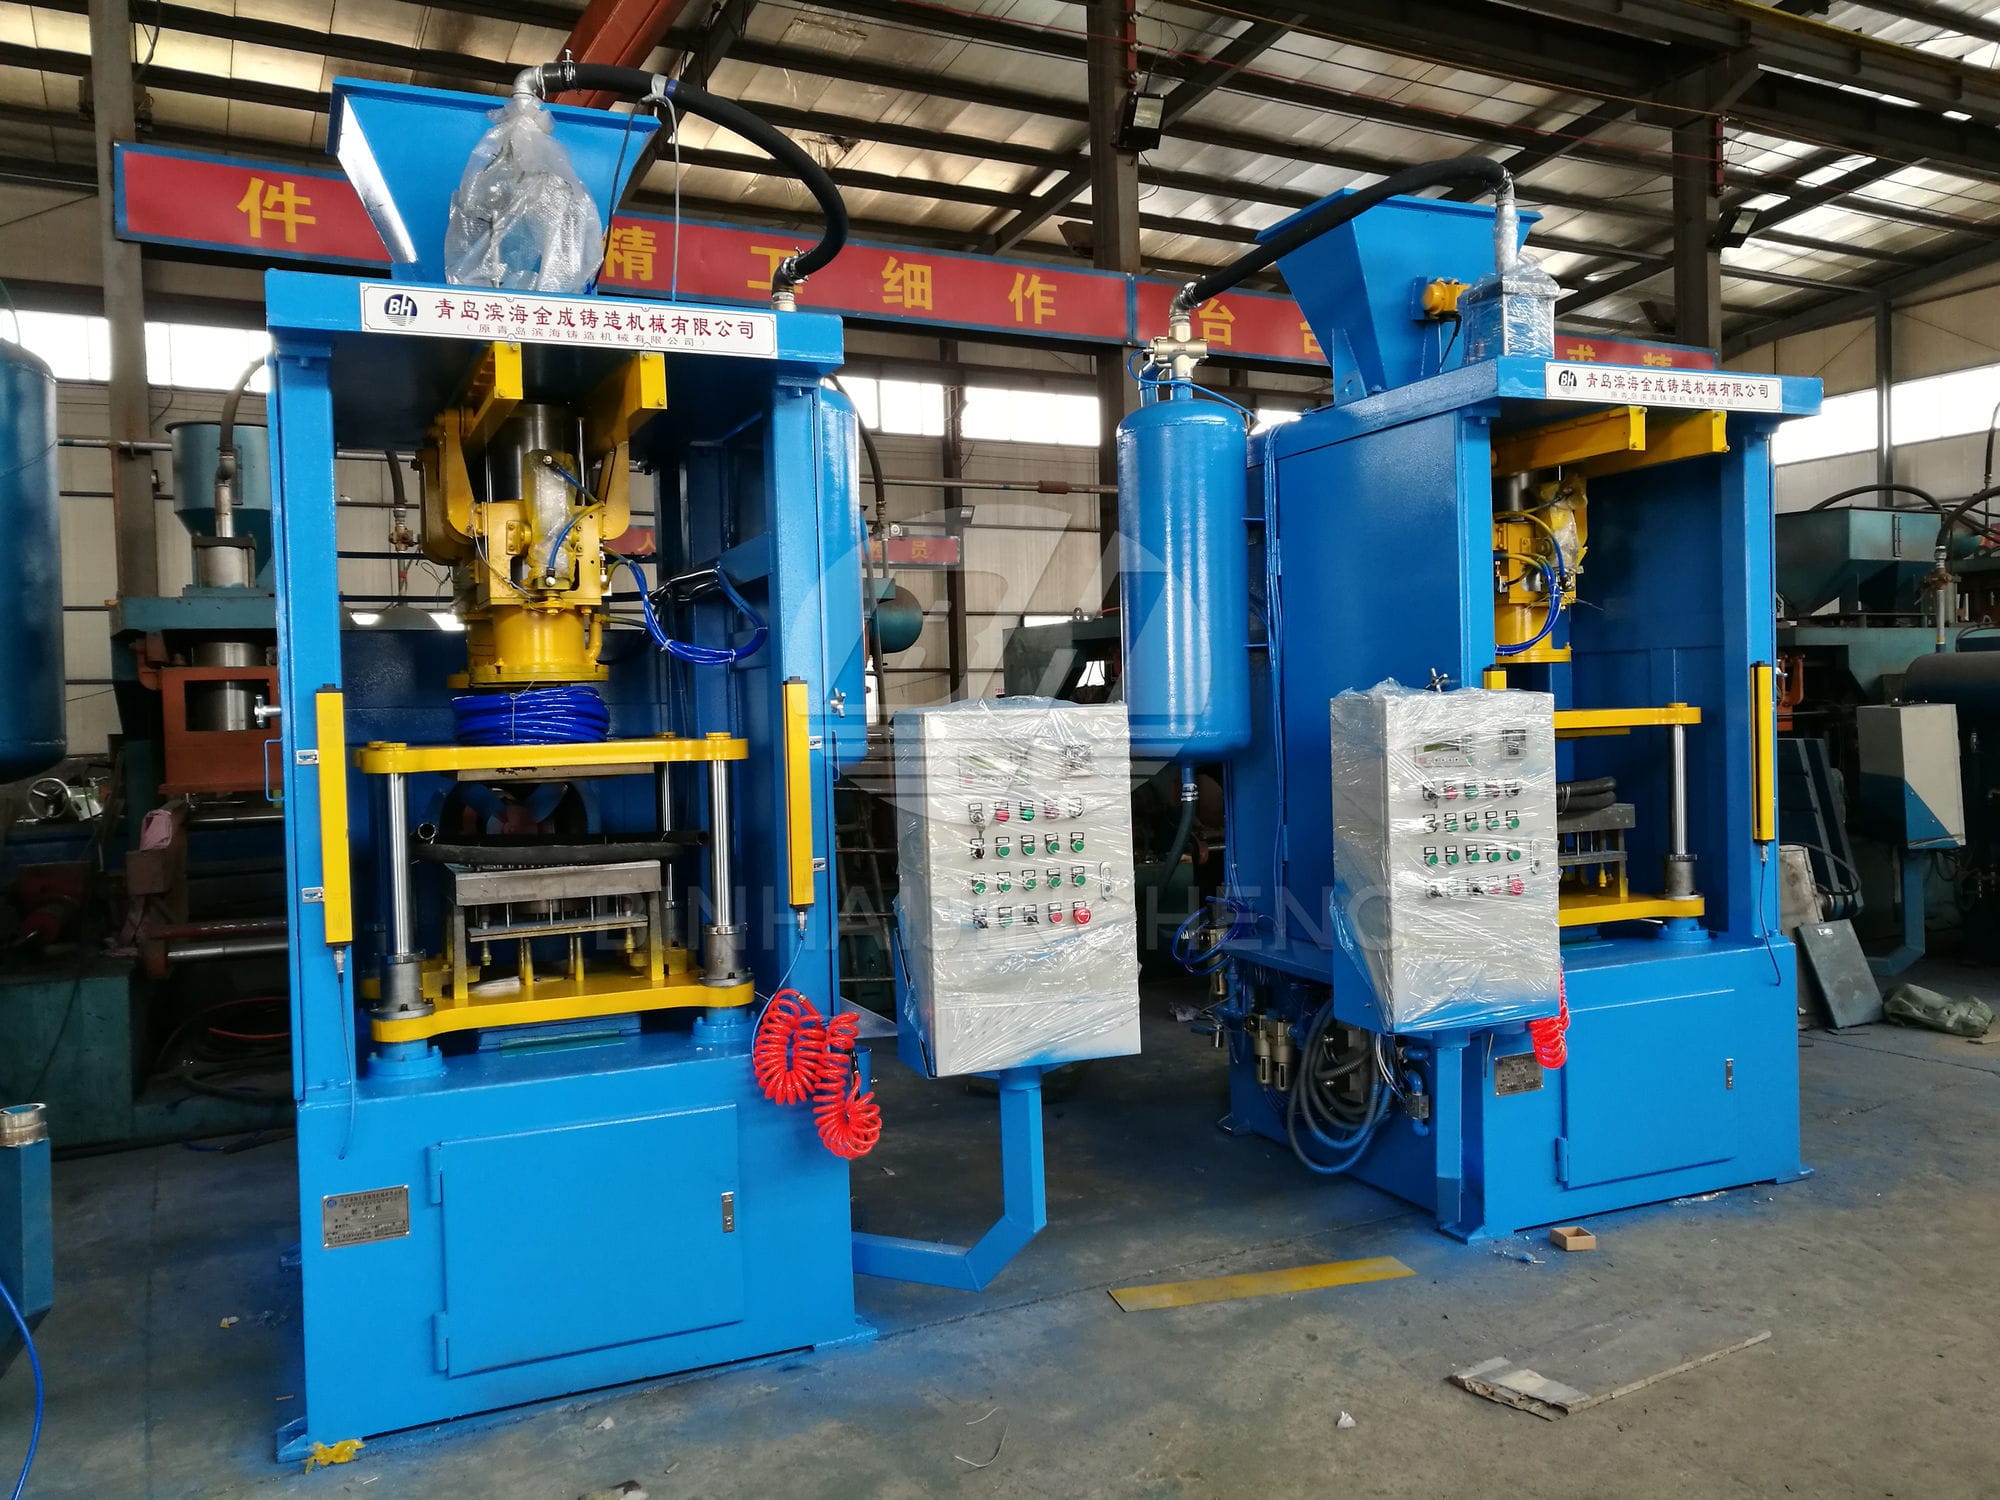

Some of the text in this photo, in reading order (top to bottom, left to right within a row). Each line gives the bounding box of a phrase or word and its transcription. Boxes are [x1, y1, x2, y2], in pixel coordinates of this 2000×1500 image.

[236, 176, 316, 243] 件
[388, 293, 413, 316] BH
[434, 297, 755, 340] 青岛滨海金成铸造机械有限公司
[1560, 370, 1576, 387] BH
[1586, 371, 1769, 399] 青岛滨海金成铸造机械有限公司
